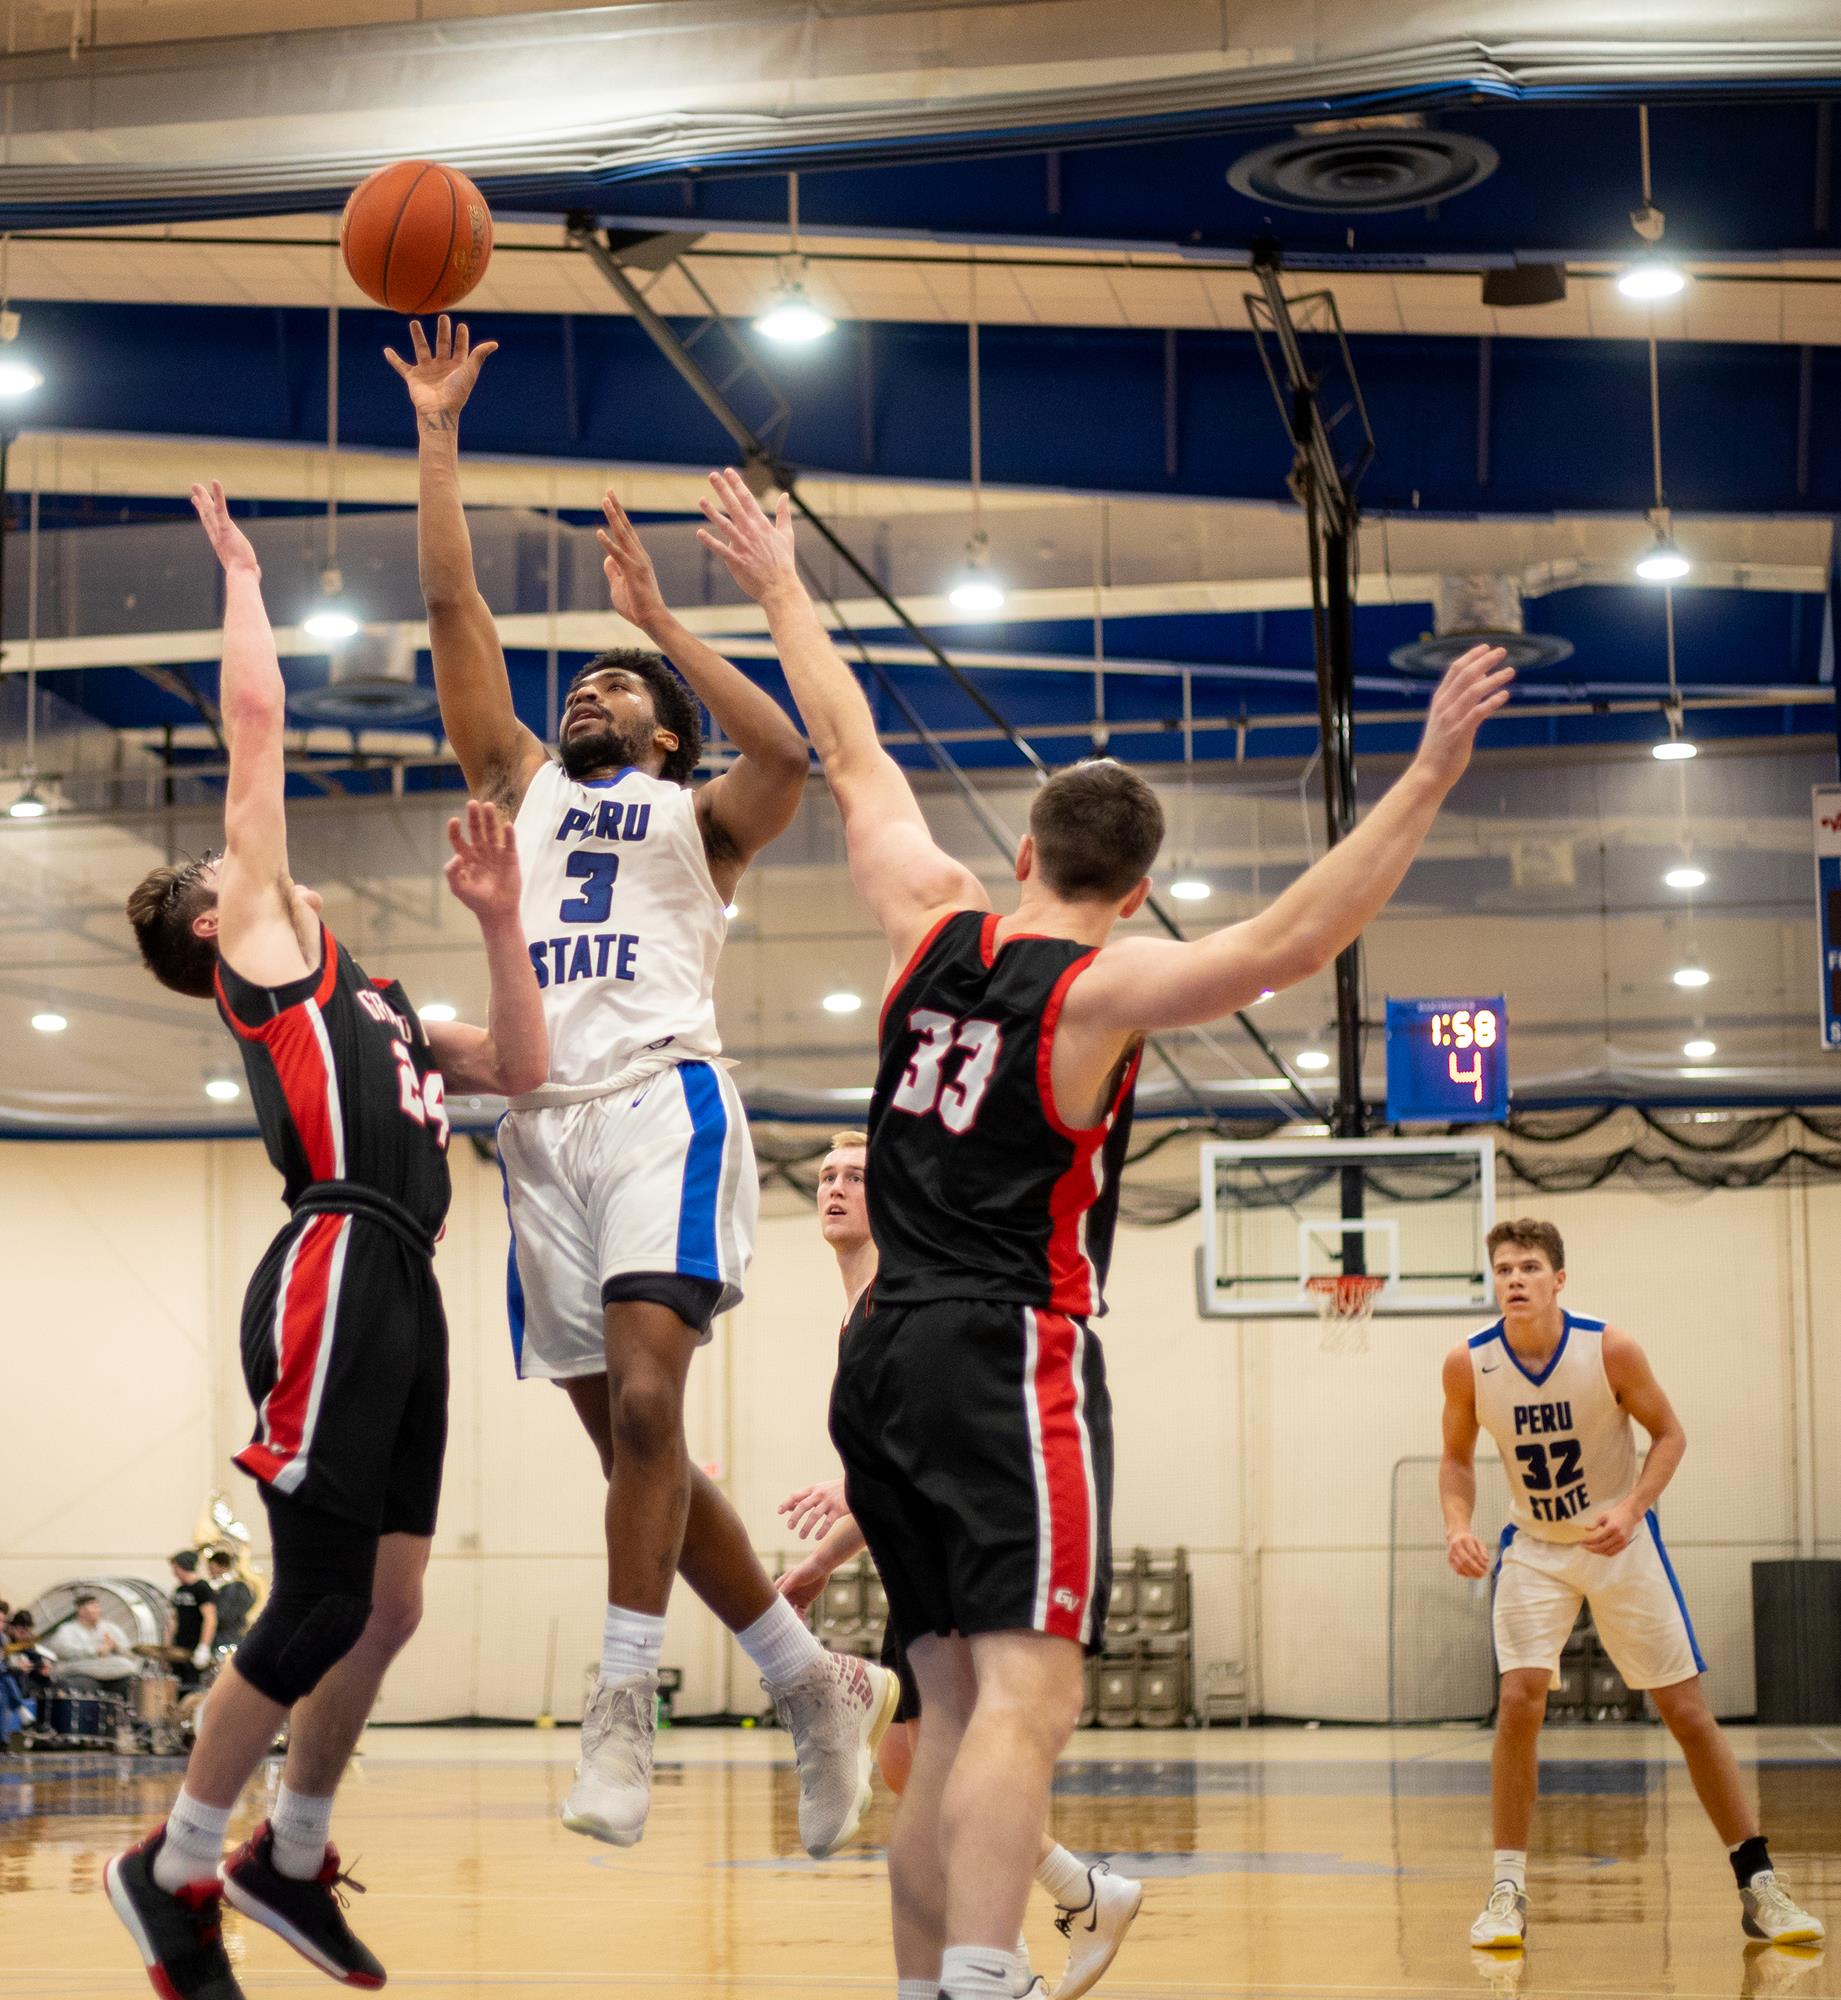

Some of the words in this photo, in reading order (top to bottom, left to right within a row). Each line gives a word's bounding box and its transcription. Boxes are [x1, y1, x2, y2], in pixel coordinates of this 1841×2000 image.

[559, 850, 620, 924] 3
[528, 933, 640, 989] STATE
[1431, 1009, 1497, 1049] 1:58
[391, 1038, 450, 1150] 24
[891, 1007, 1003, 1136] 33
[1448, 1050, 1483, 1104] 4
[1513, 1400, 1574, 1436] PERU
[1514, 1438, 1584, 1491] 32
[1529, 1483, 1591, 1523] STATE
